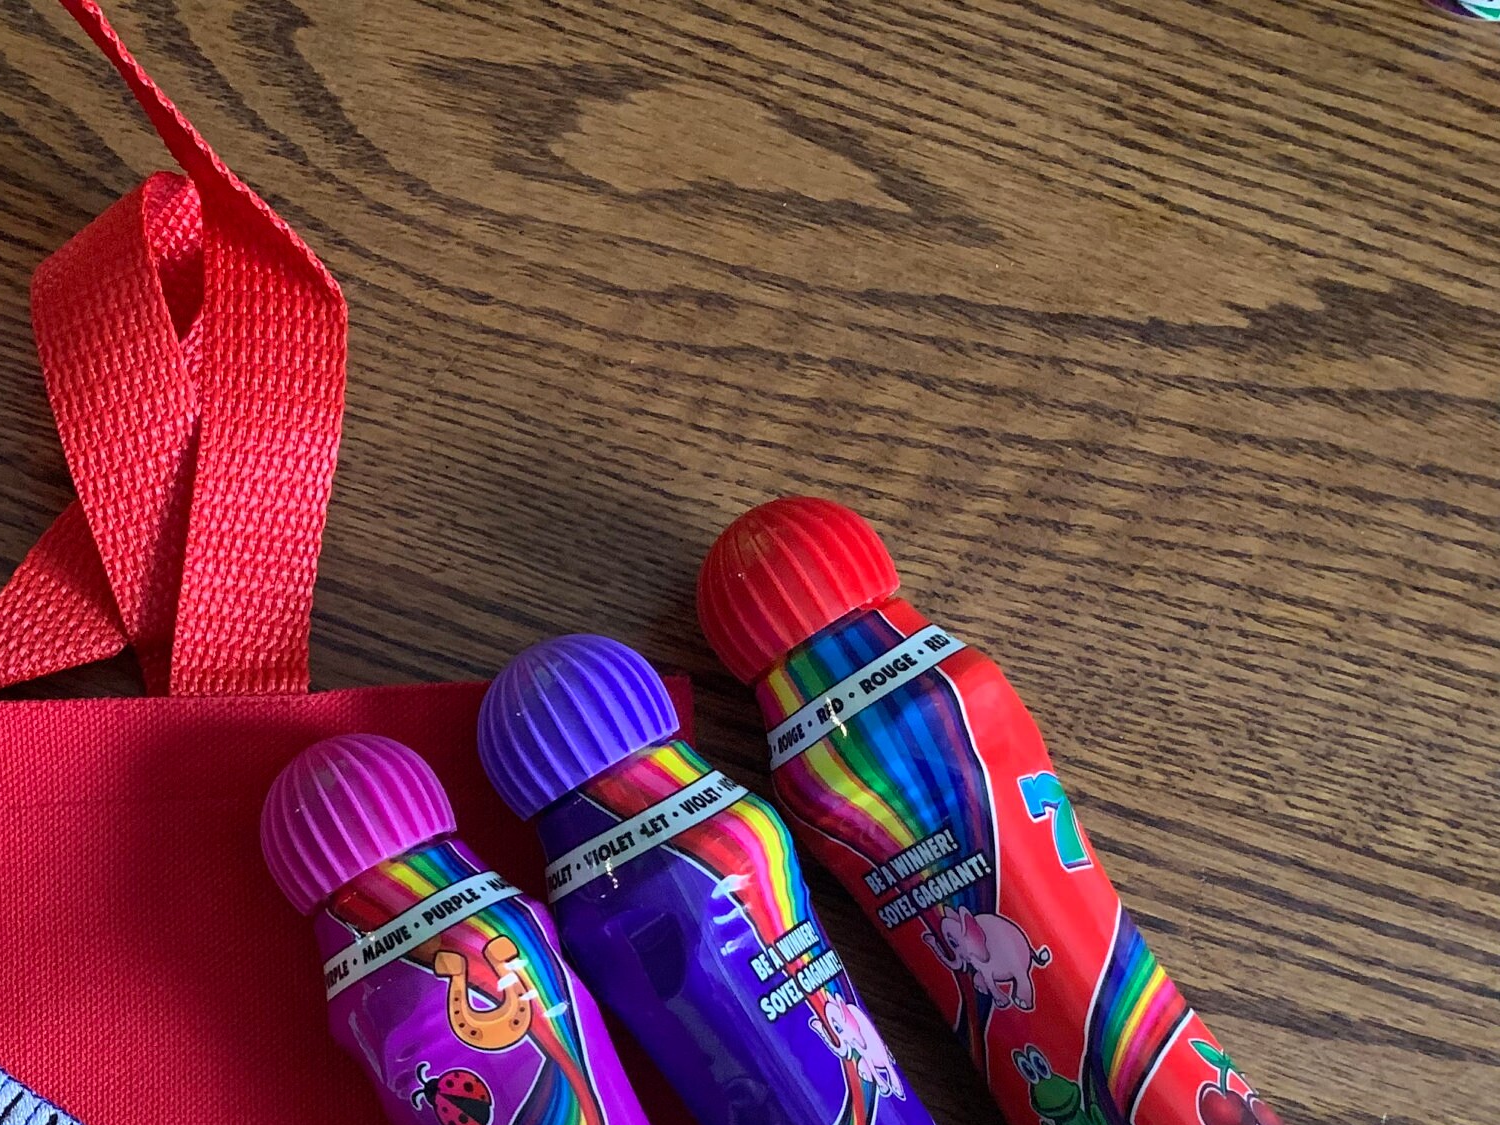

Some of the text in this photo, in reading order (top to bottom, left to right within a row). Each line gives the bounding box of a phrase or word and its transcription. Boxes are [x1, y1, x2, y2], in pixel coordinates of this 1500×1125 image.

[858, 650, 918, 696] ROUGE
[582, 827, 636, 871] VIOLET
[680, 785, 719, 818] VIOLET
[1017, 772, 1093, 871] 7
[865, 829, 959, 895] BE A WINNER!
[878, 853, 993, 929] SOYEZ GAGNANT!
[361, 925, 411, 964] MAUVE
[422, 885, 480, 926] PURPLE
[751, 921, 820, 981] BE A WINNER!
[760, 950, 843, 1021] SOYEZ GAGNANT!
